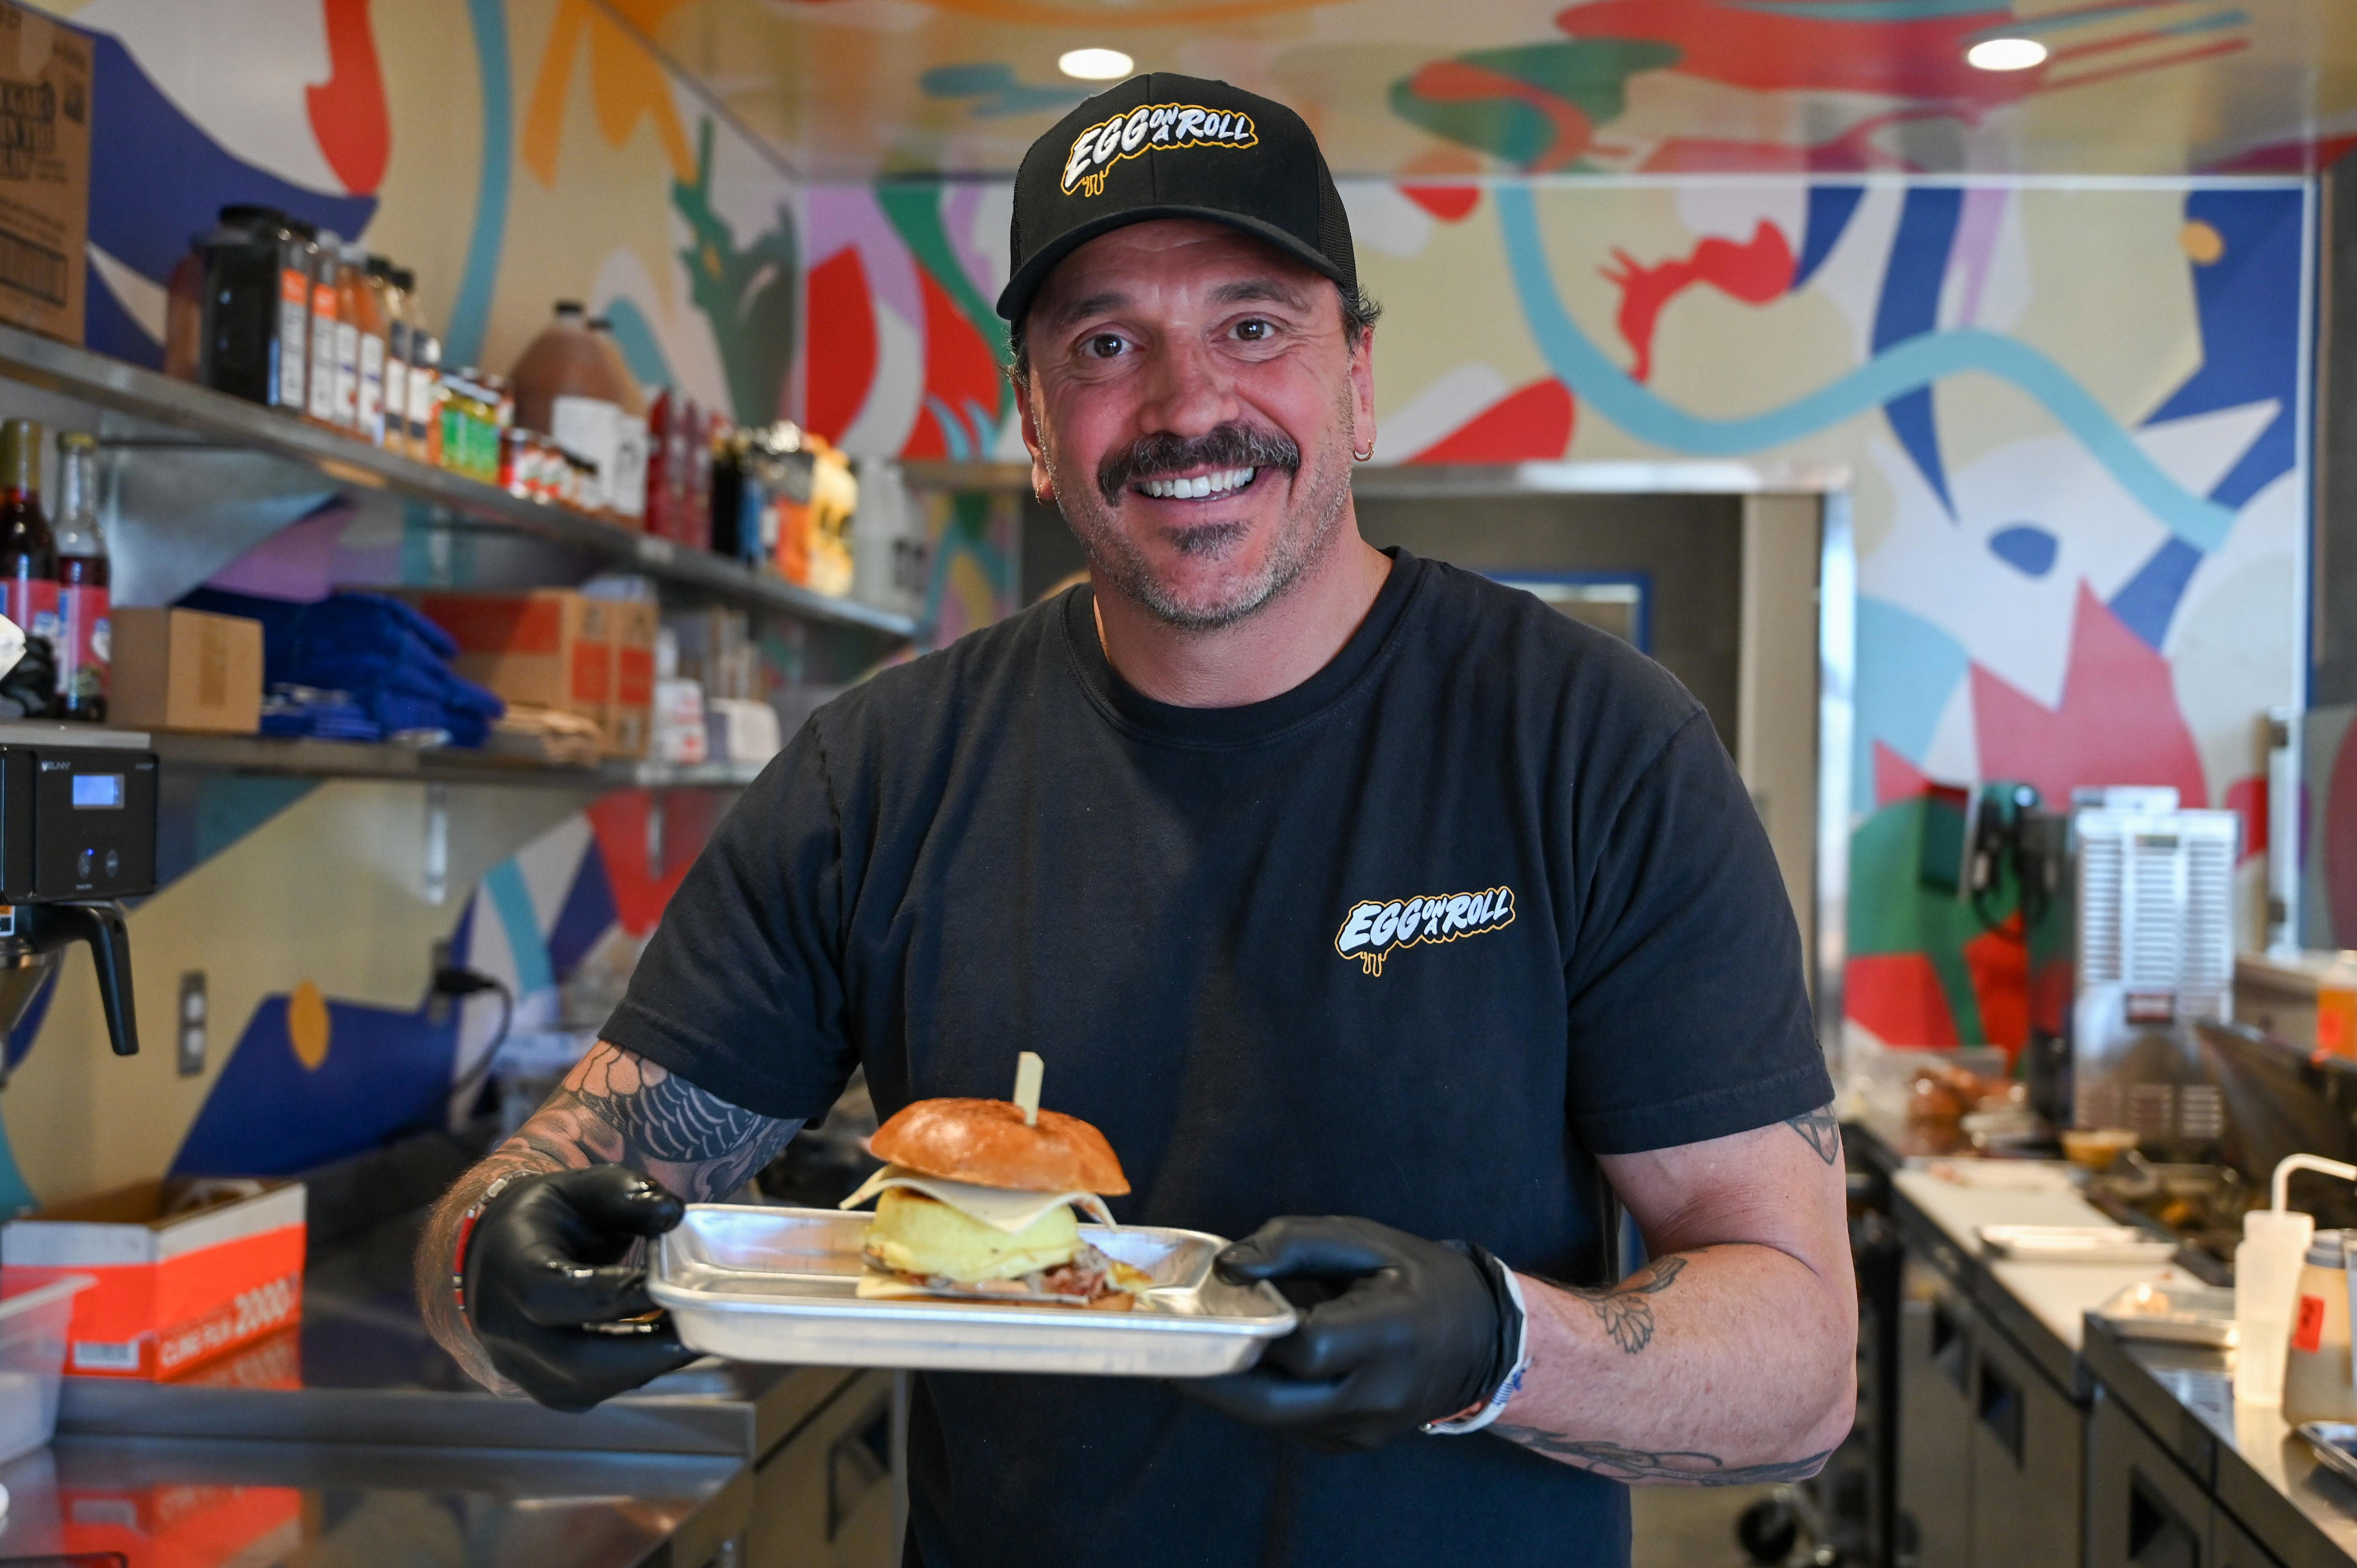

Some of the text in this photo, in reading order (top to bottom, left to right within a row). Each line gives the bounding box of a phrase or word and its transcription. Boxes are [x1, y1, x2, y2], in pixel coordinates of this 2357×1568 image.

[1065, 106, 1249, 187] EGG ON A ROLL
[1338, 889, 1508, 951] EGG ON A ROLL
